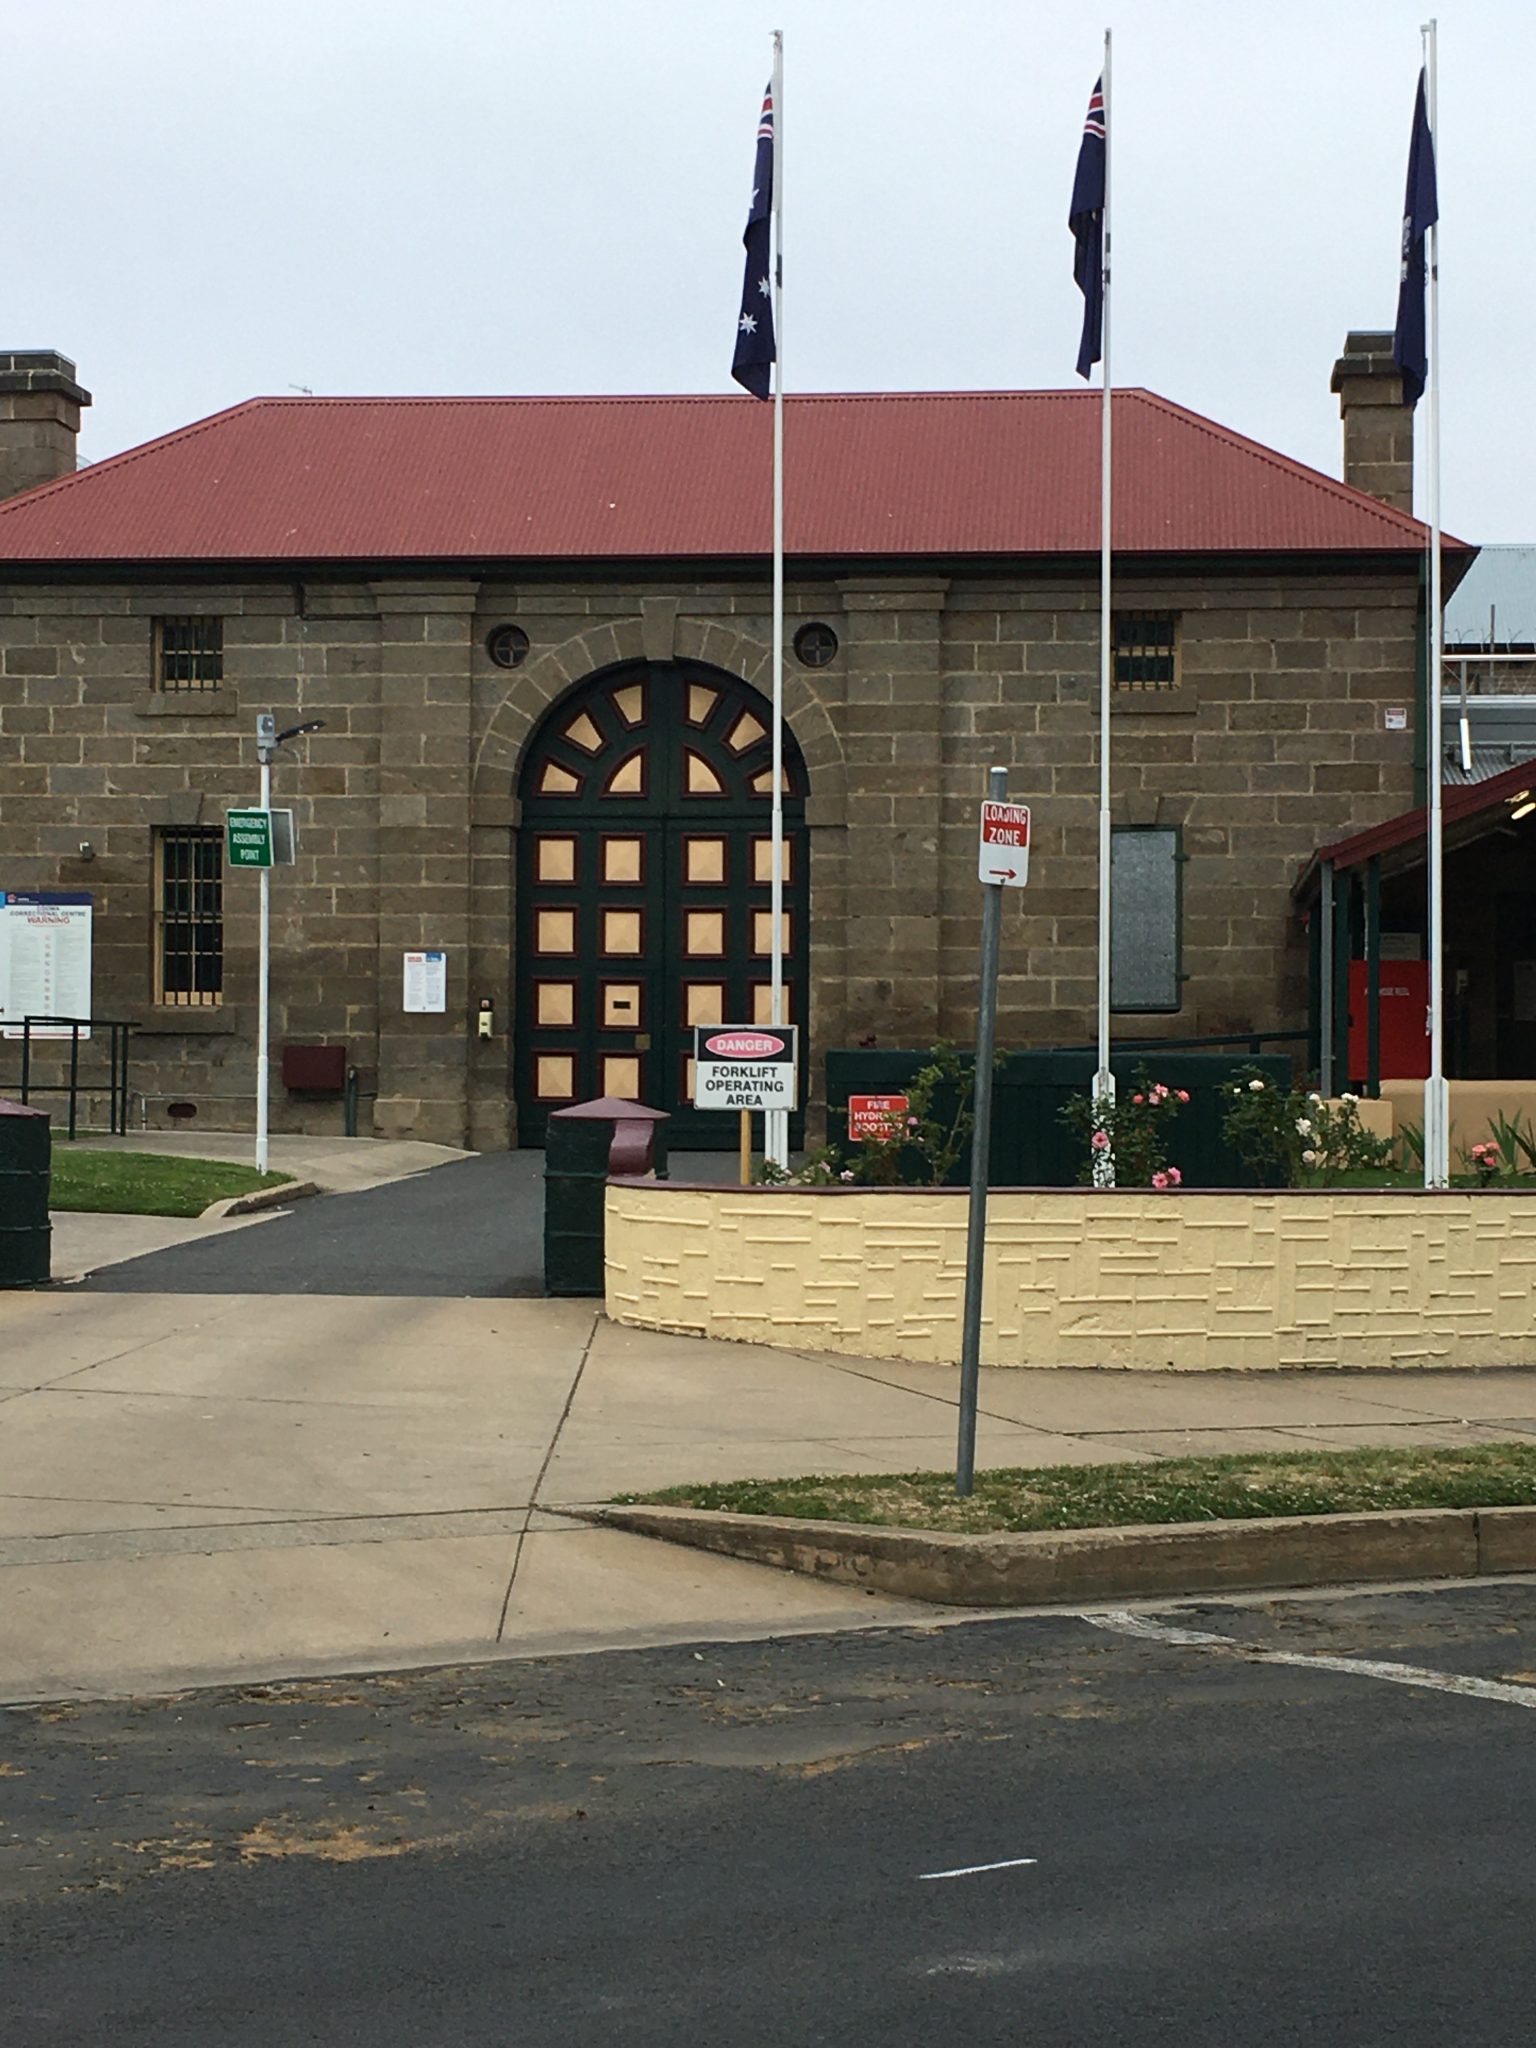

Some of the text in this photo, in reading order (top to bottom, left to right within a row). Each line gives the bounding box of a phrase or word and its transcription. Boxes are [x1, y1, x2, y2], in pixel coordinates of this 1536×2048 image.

[985, 805, 1027, 825] LOADING
[229, 817, 267, 829] EMERGENCY
[232, 833, 265, 845] ASSEMBLY
[989, 827, 1021, 846] ZONE
[240, 849, 259, 861] POINT
[27, 916, 70, 925] WARNING
[716, 1039, 773, 1052] DANGER
[712, 1066, 778, 1078] FORKLIFT
[705, 1080, 784, 1092] OPERATING
[726, 1094, 763, 1106] AREA
[867, 1100, 890, 1110] FIRE
